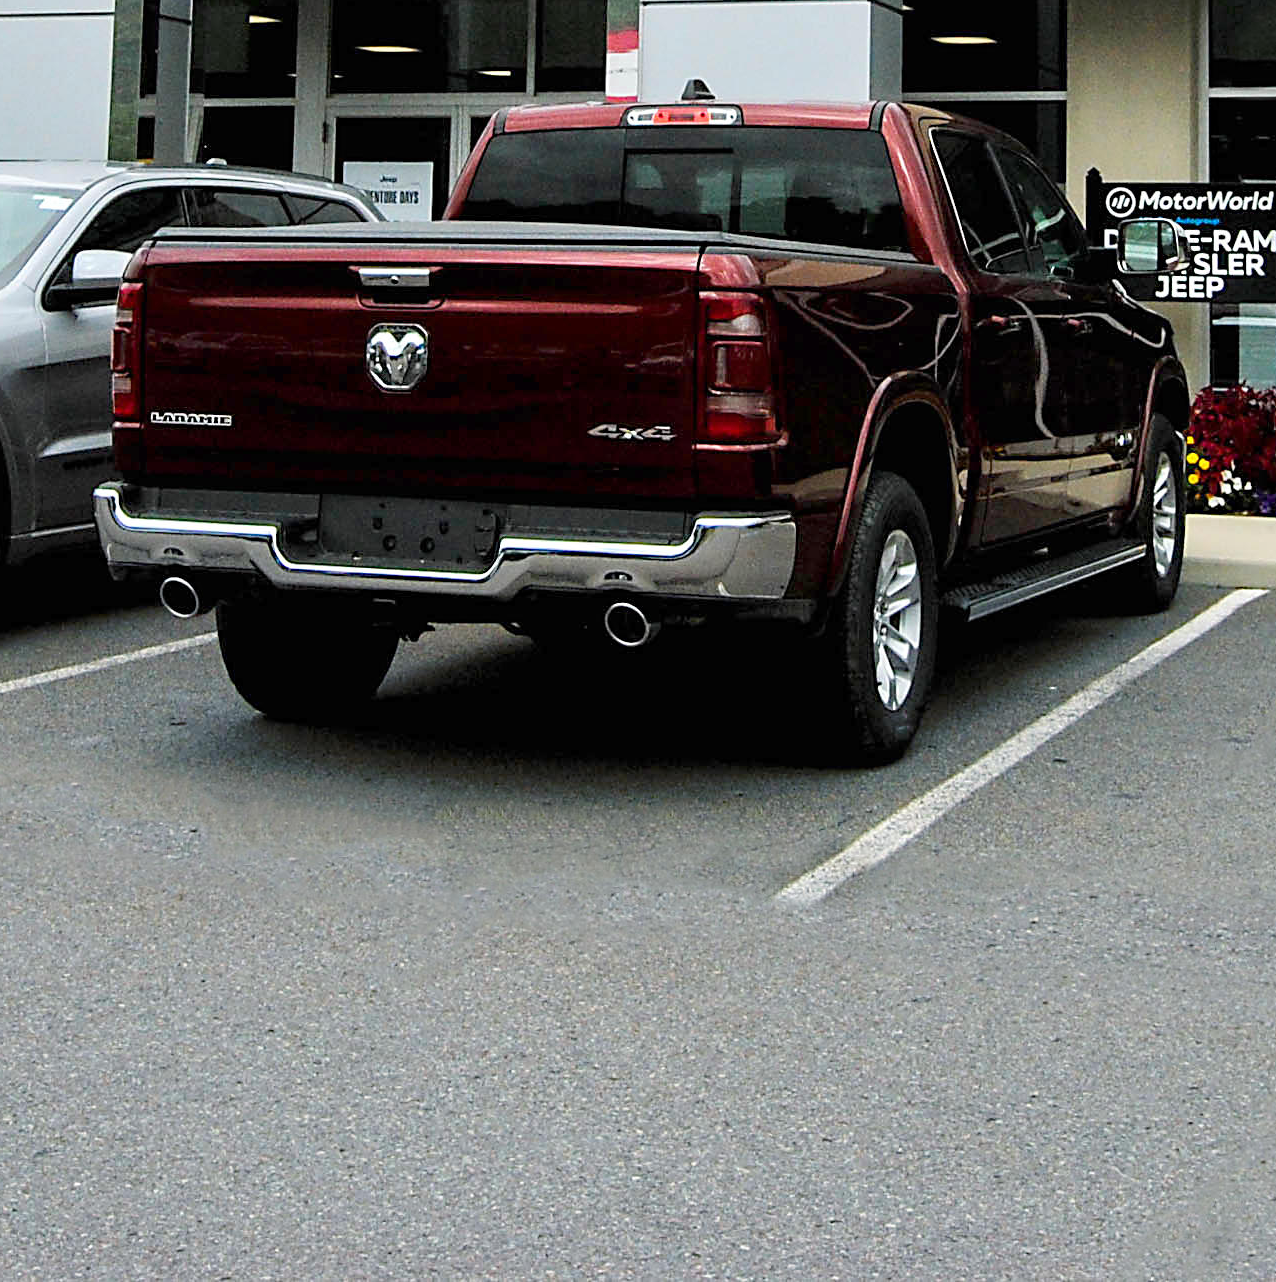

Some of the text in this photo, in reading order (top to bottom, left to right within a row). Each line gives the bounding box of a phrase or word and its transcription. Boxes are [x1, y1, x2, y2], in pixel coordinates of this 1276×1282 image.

[399, 190, 419, 205] DAYS
[1138, 190, 1275, 211] MotorWorld
[1154, 274, 1225, 299] JEEP
[150, 411, 233, 427] LARAMIE
